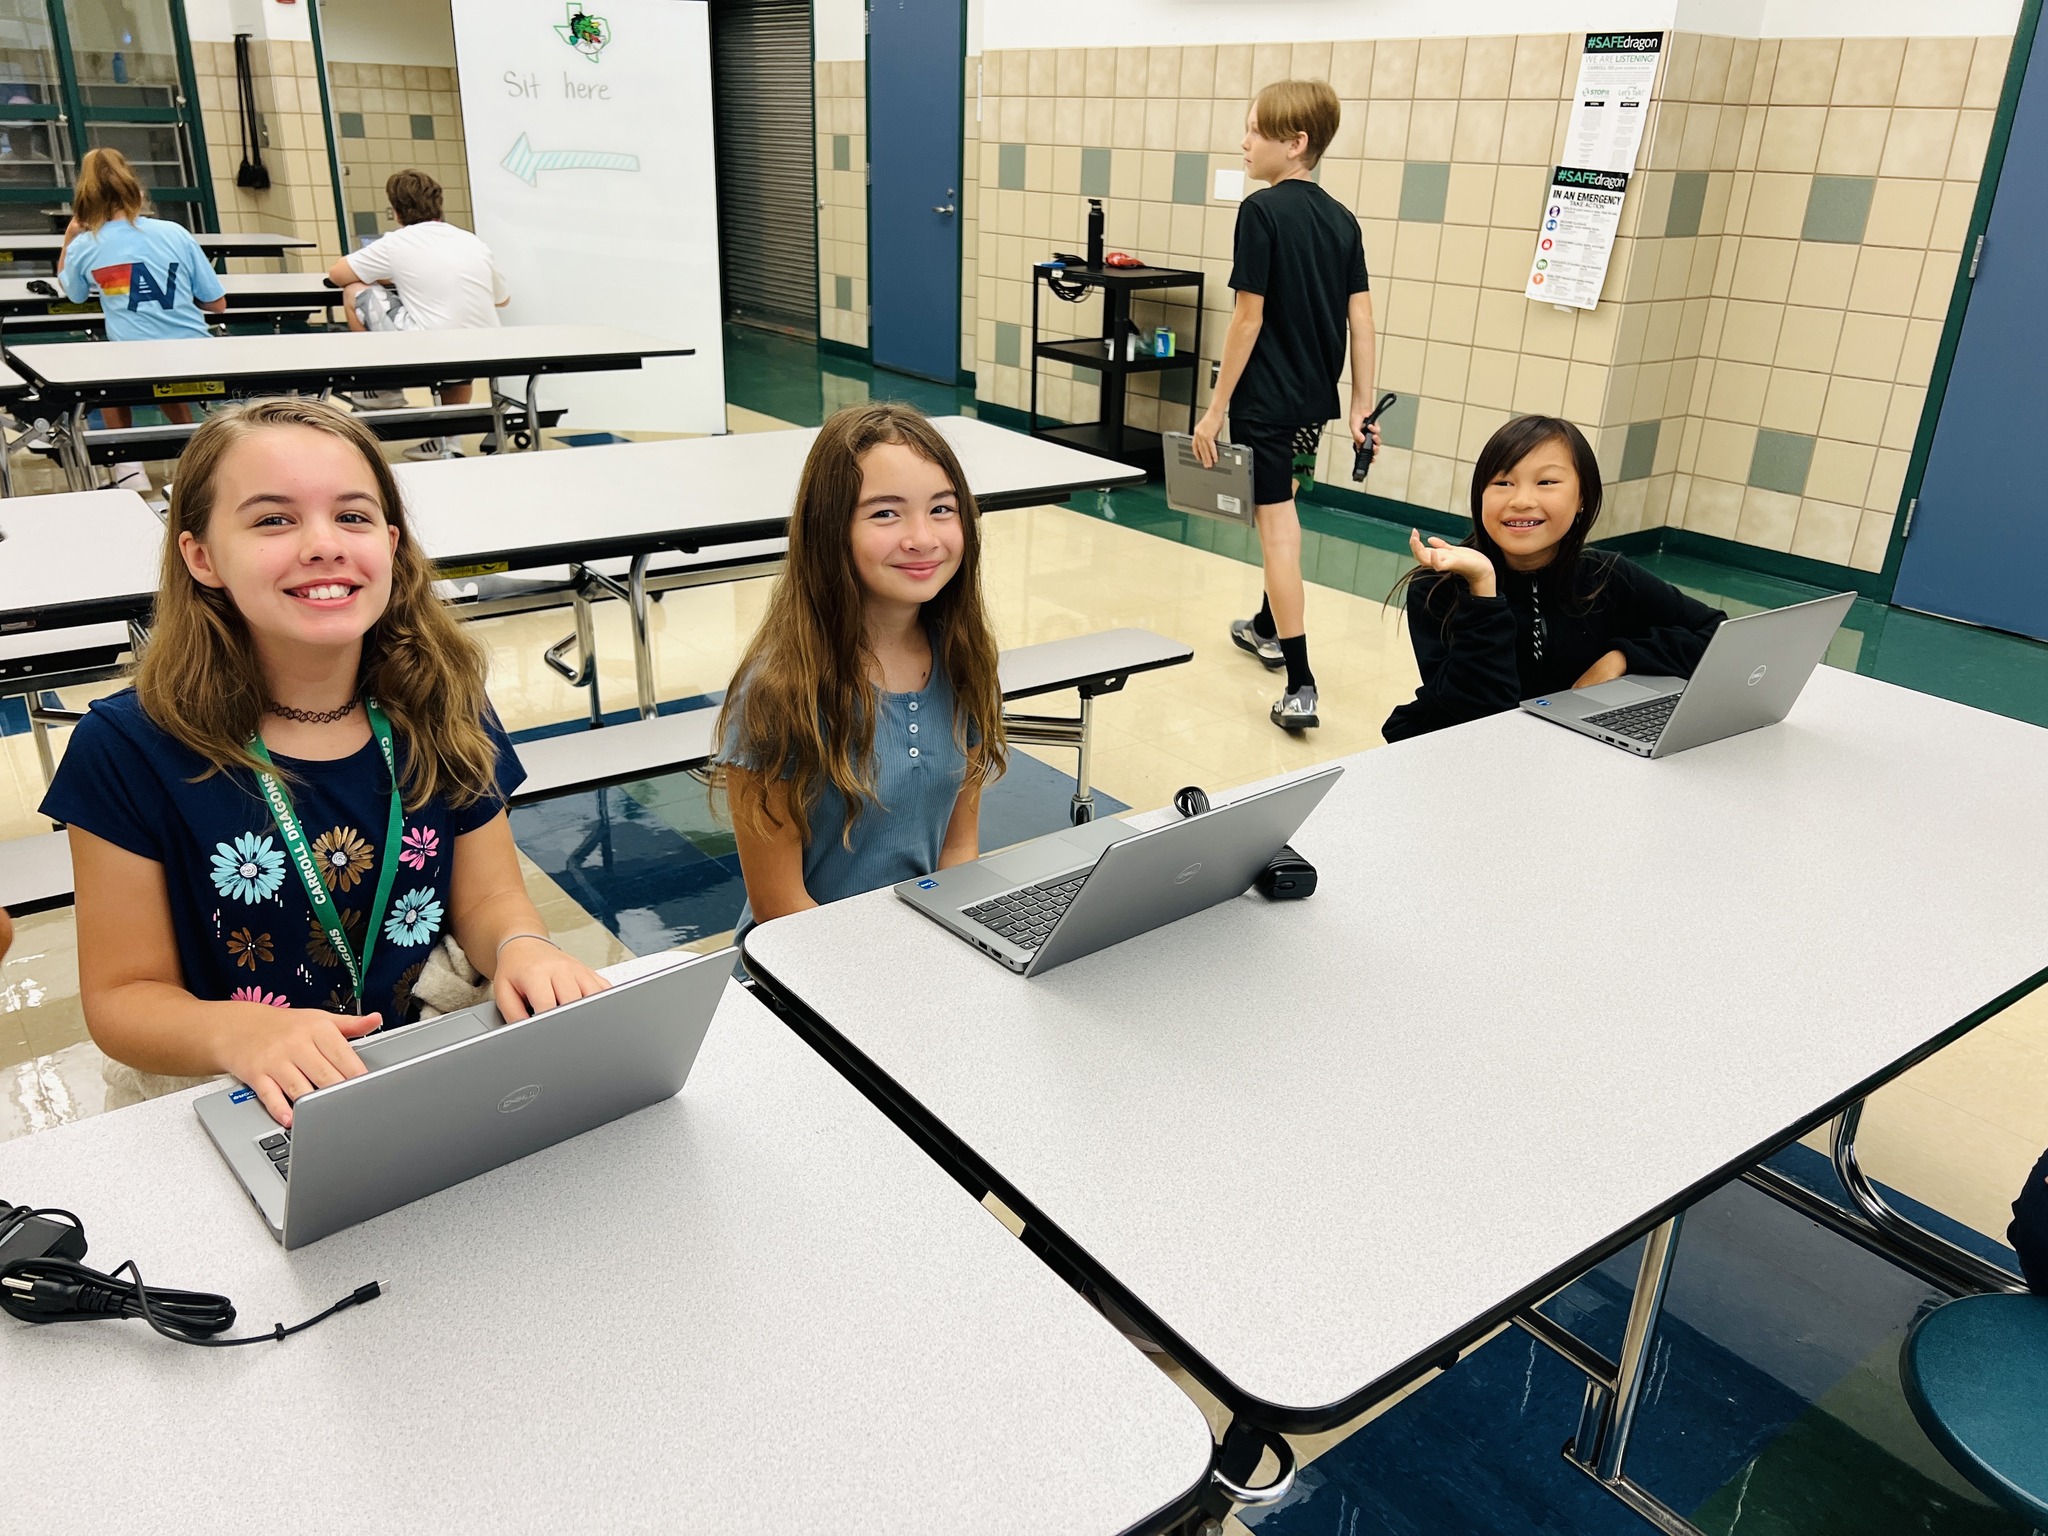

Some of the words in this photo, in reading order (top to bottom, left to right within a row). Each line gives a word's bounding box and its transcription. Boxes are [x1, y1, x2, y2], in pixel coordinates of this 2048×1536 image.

[1587, 35, 1658, 51] #SAFEdragon
[1585, 55, 1598, 63] WE
[1599, 55, 1614, 63] ARE
[1615, 54, 1655, 63] LISTENING!
[503, 71, 541, 99] Sit
[563, 71, 612, 100] here
[1557, 171, 1626, 190] #SAFEdragon
[1552, 189, 1562, 199] IN
[1563, 190, 1575, 200] AN
[1577, 192, 1622, 206] EMERGENCY
[1570, 200, 1583, 208] TAKE
[1585, 202, 1605, 210] ACTION
[261, 772, 301, 842] DRAGONS
[294, 841, 327, 905] CARROLL
[328, 928, 359, 987] DRAGONS
